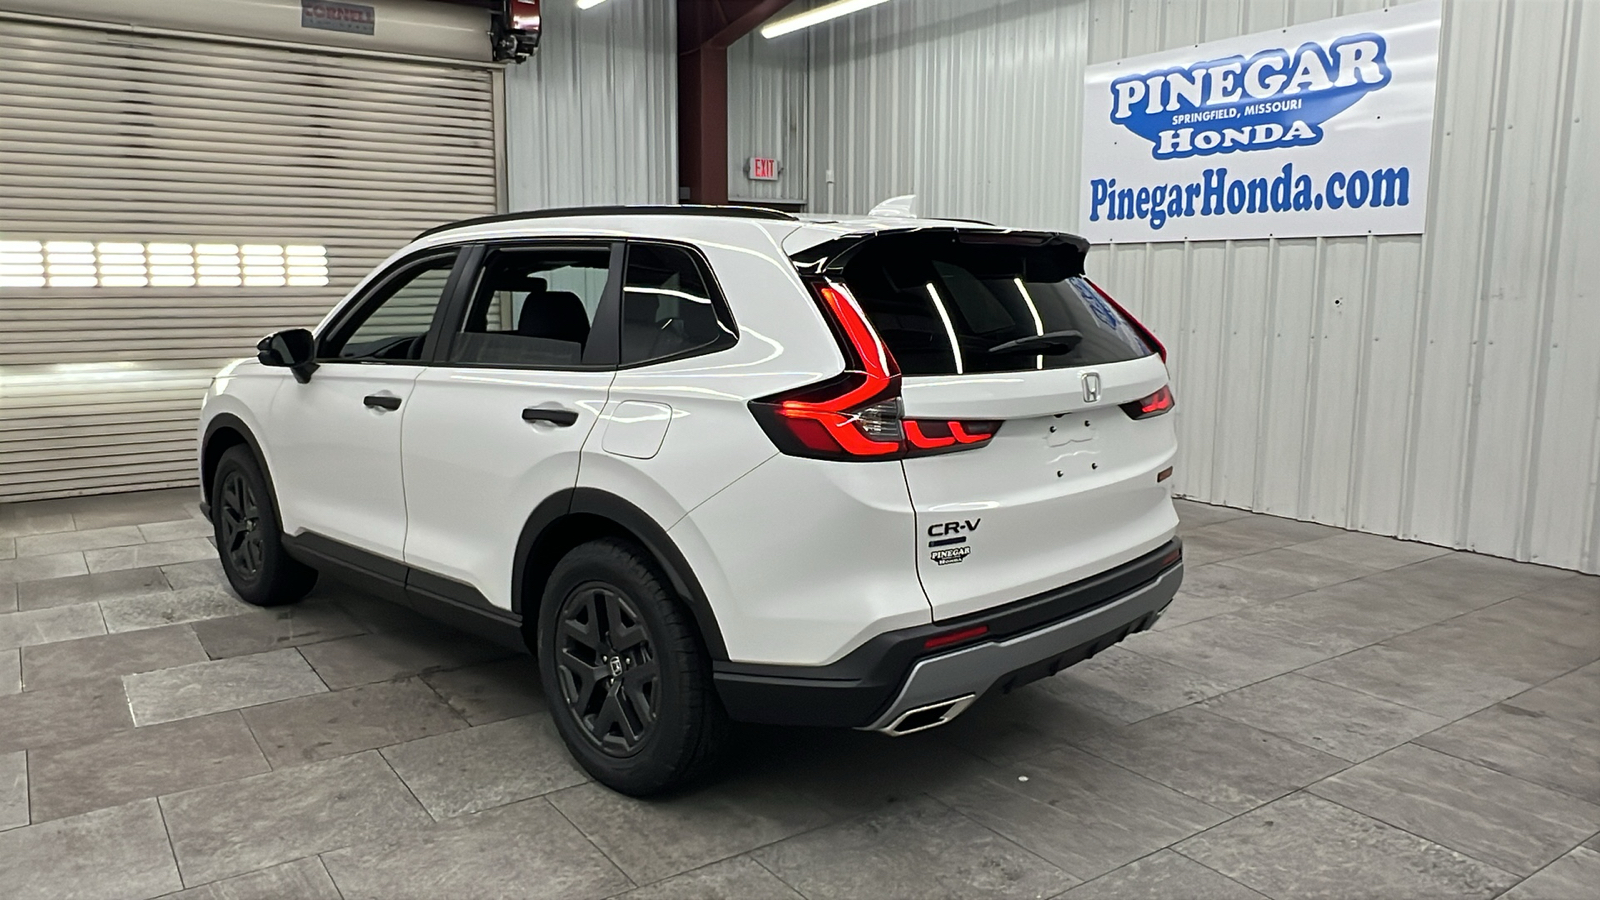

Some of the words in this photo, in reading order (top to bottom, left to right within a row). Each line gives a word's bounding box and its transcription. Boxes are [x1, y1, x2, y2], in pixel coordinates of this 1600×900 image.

[1113, 40, 1384, 119] PINEGAR
[1172, 107, 1241, 125] SPRINGFIELD,
[1244, 99, 1302, 116] MISSOURI
[1157, 120, 1317, 154] HONDA
[755, 158, 774, 178] EXIT
[1089, 162, 1410, 230] PinegarHonda.com
[928, 518, 981, 537] CR-V
[932, 547, 970, 560] PINEGAR
